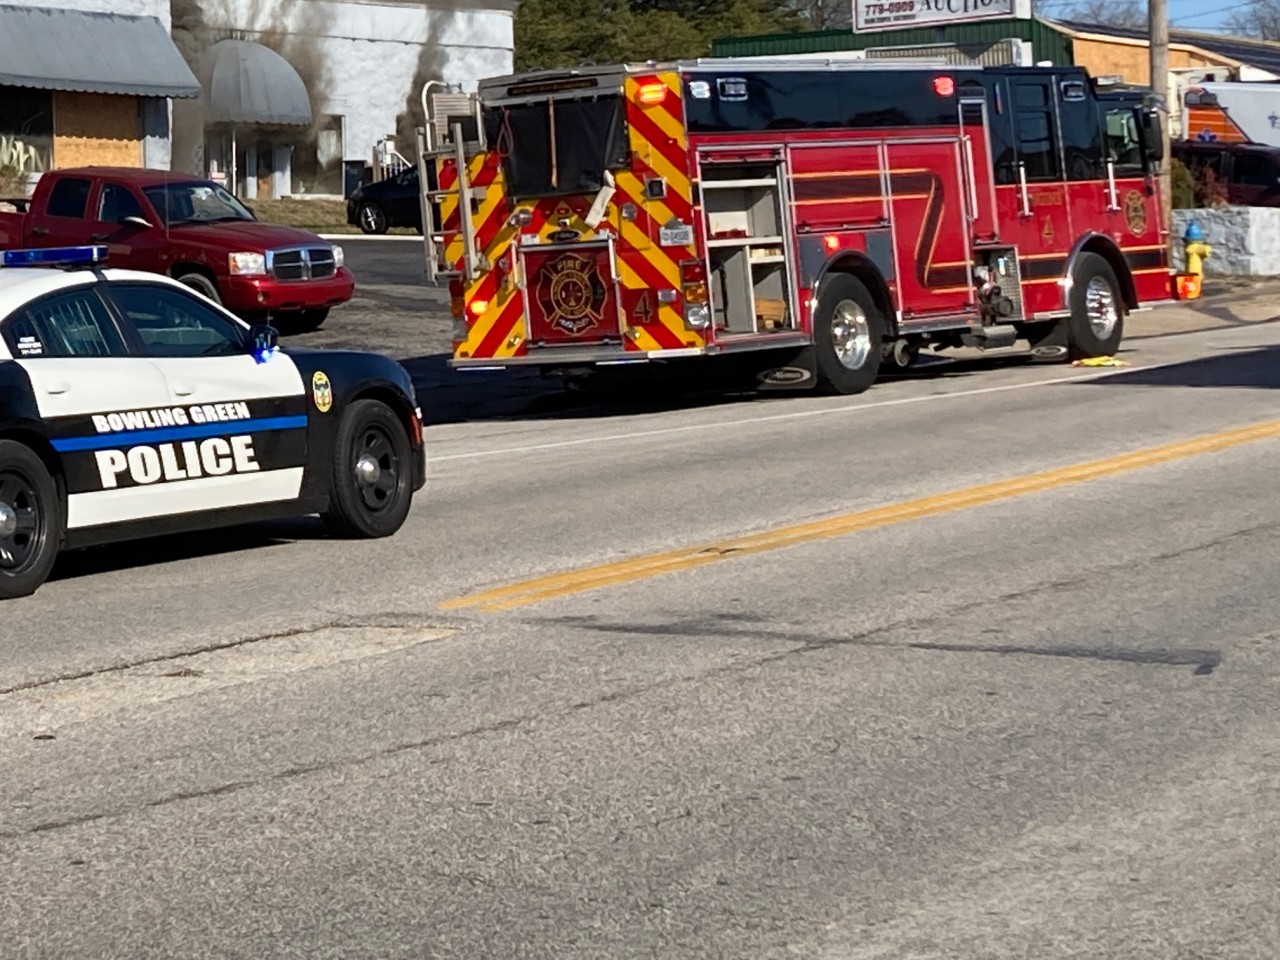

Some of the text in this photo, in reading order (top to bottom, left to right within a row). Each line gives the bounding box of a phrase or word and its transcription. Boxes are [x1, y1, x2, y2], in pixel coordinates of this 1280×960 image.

[557, 259, 582, 271] FIRE
[633, 291, 654, 324] 4
[91, 402, 251, 433] BOWLING GREEN
[94, 435, 260, 489] POLICE
